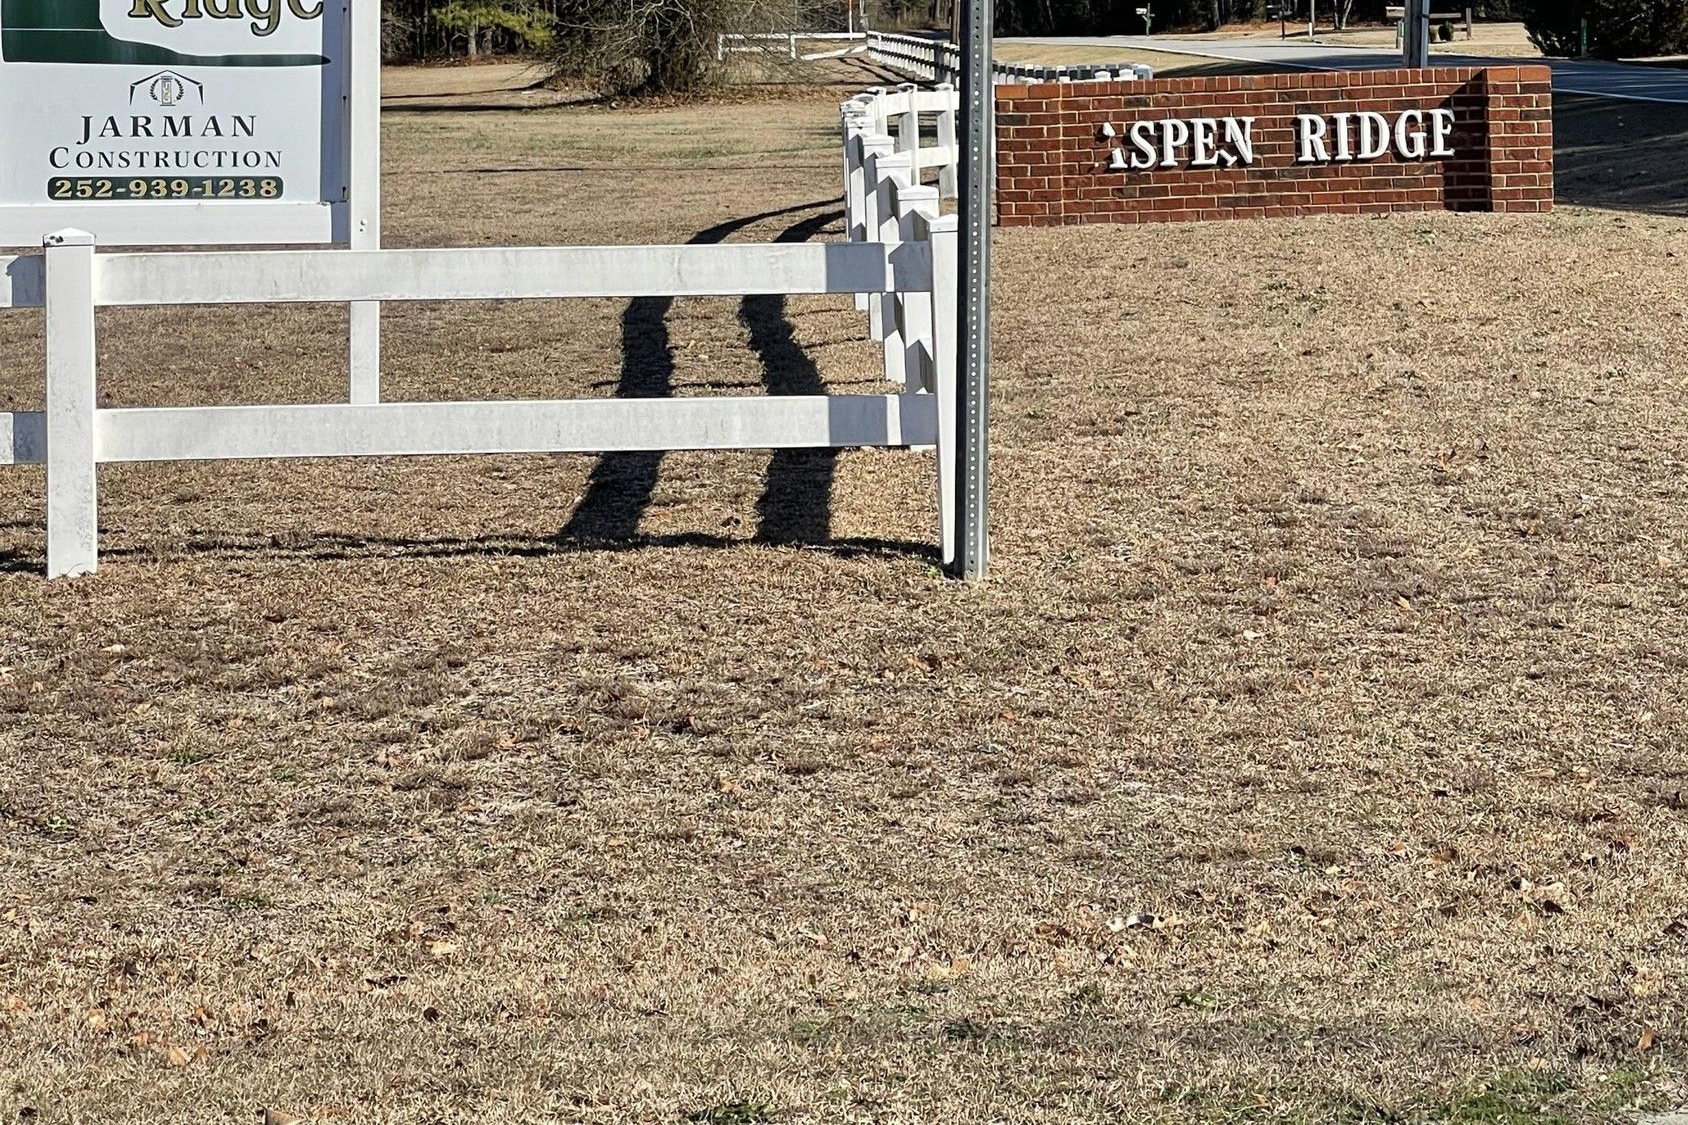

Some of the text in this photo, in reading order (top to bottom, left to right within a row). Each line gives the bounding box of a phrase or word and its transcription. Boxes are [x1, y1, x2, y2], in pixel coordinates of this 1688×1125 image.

[76, 115, 257, 145] JARMAN
[1298, 108, 1456, 161] RIDGE
[49, 146, 281, 169] CONSTRUCTION
[54, 178, 278, 199] 252-939-1238
